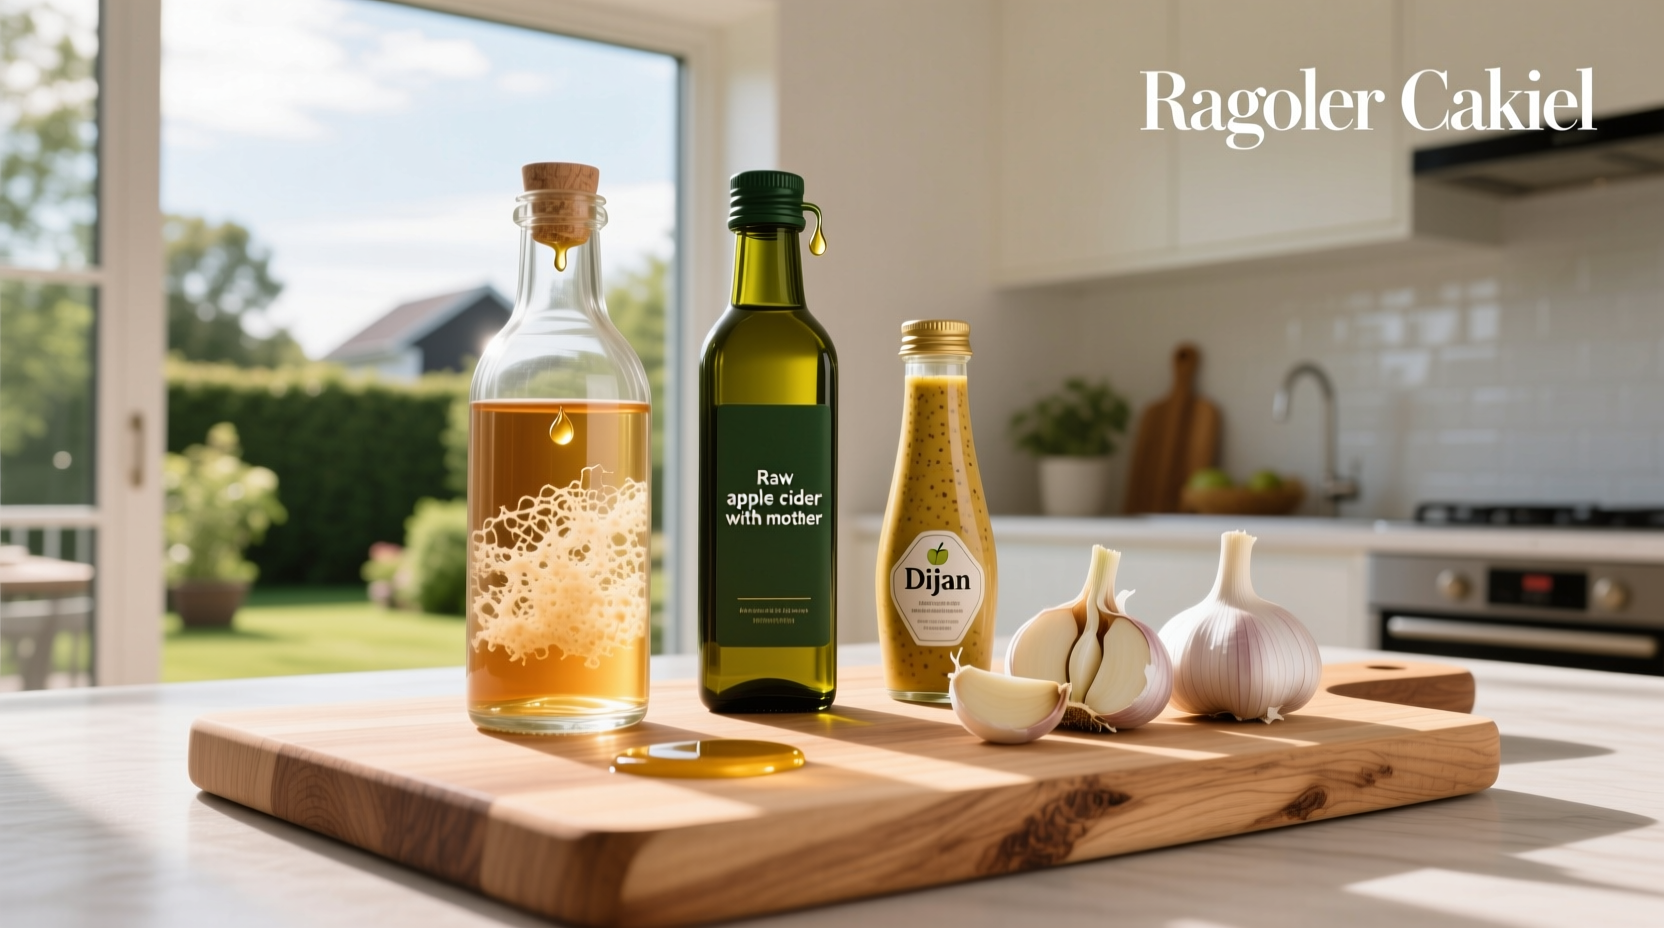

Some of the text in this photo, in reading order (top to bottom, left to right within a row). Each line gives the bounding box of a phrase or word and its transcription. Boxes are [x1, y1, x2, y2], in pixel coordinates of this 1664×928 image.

[757, 469, 794, 486] Raw
[726, 488, 823, 511] apple cider
[725, 509, 823, 526] with mother
[904, 567, 972, 597] Dijan
